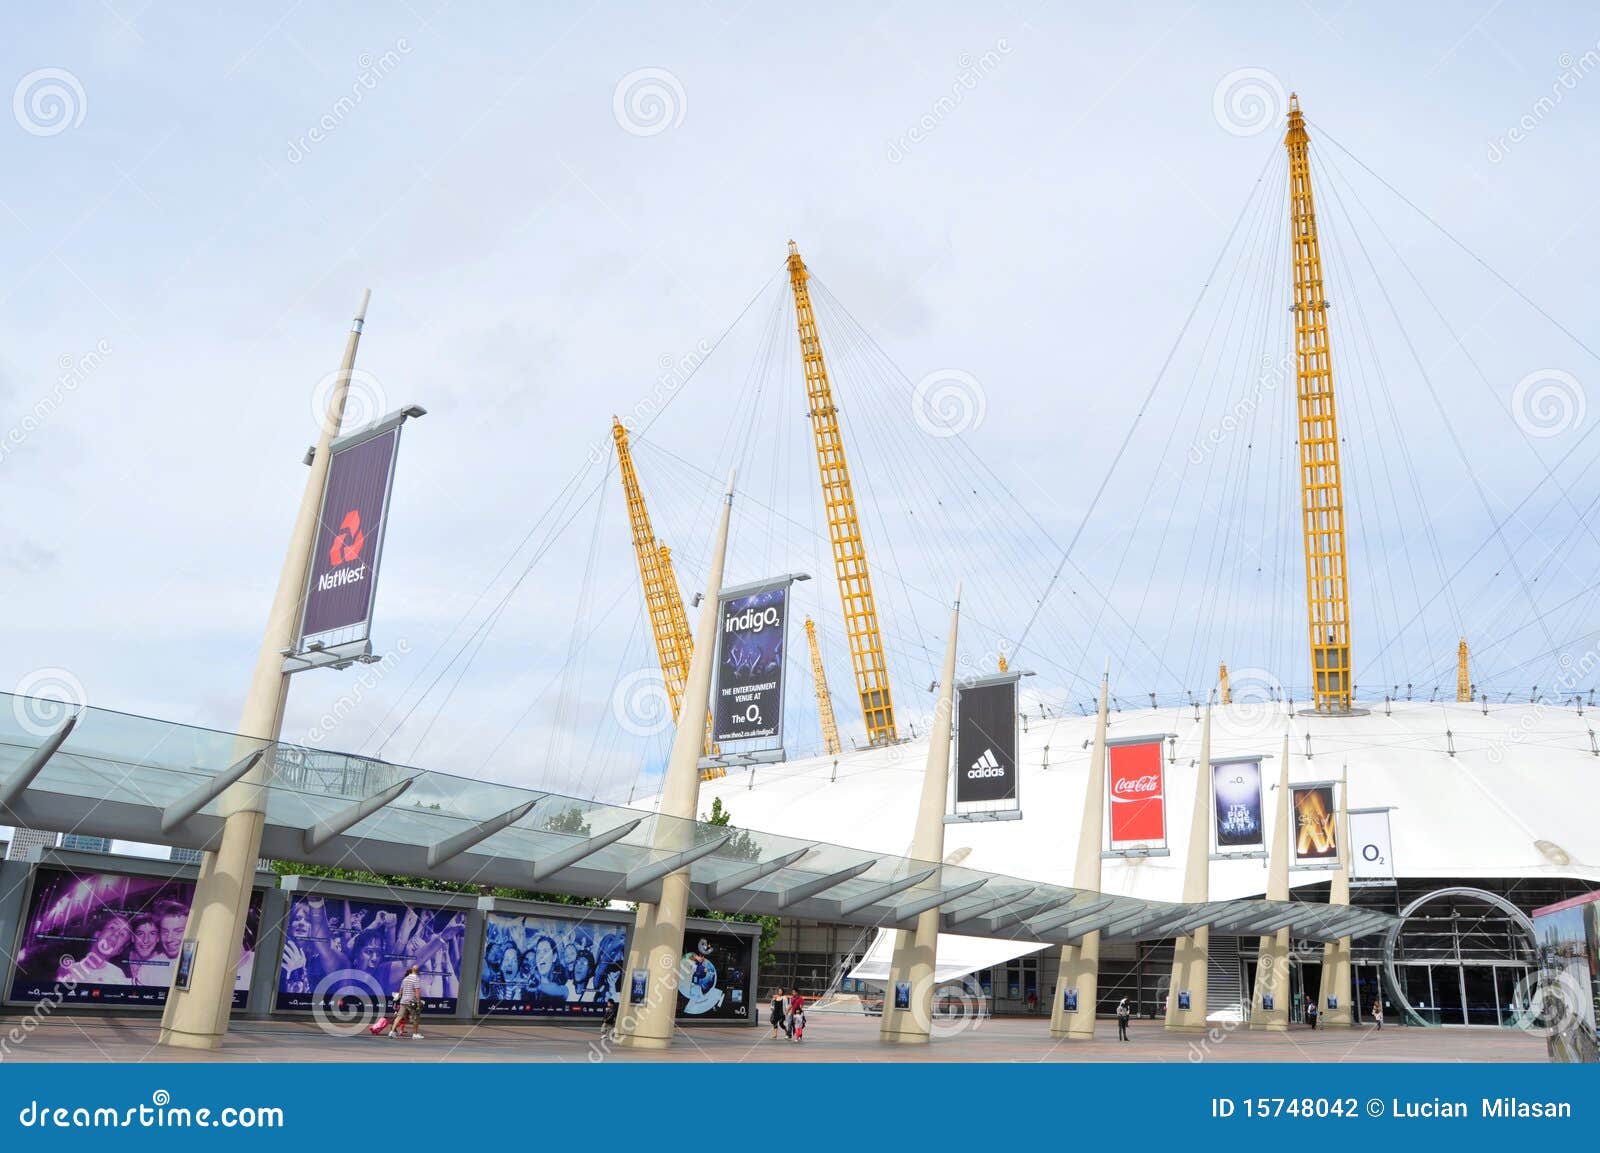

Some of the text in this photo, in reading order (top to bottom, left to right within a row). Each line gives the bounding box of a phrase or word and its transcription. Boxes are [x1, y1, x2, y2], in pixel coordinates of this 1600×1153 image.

[318, 563, 366, 592] NatWest
[721, 681, 777, 697] THE ENTERTAINMENT
[735, 692, 762, 703] VENUE AT
[731, 714, 746, 724] The
[967, 766, 1004, 779] adidas
